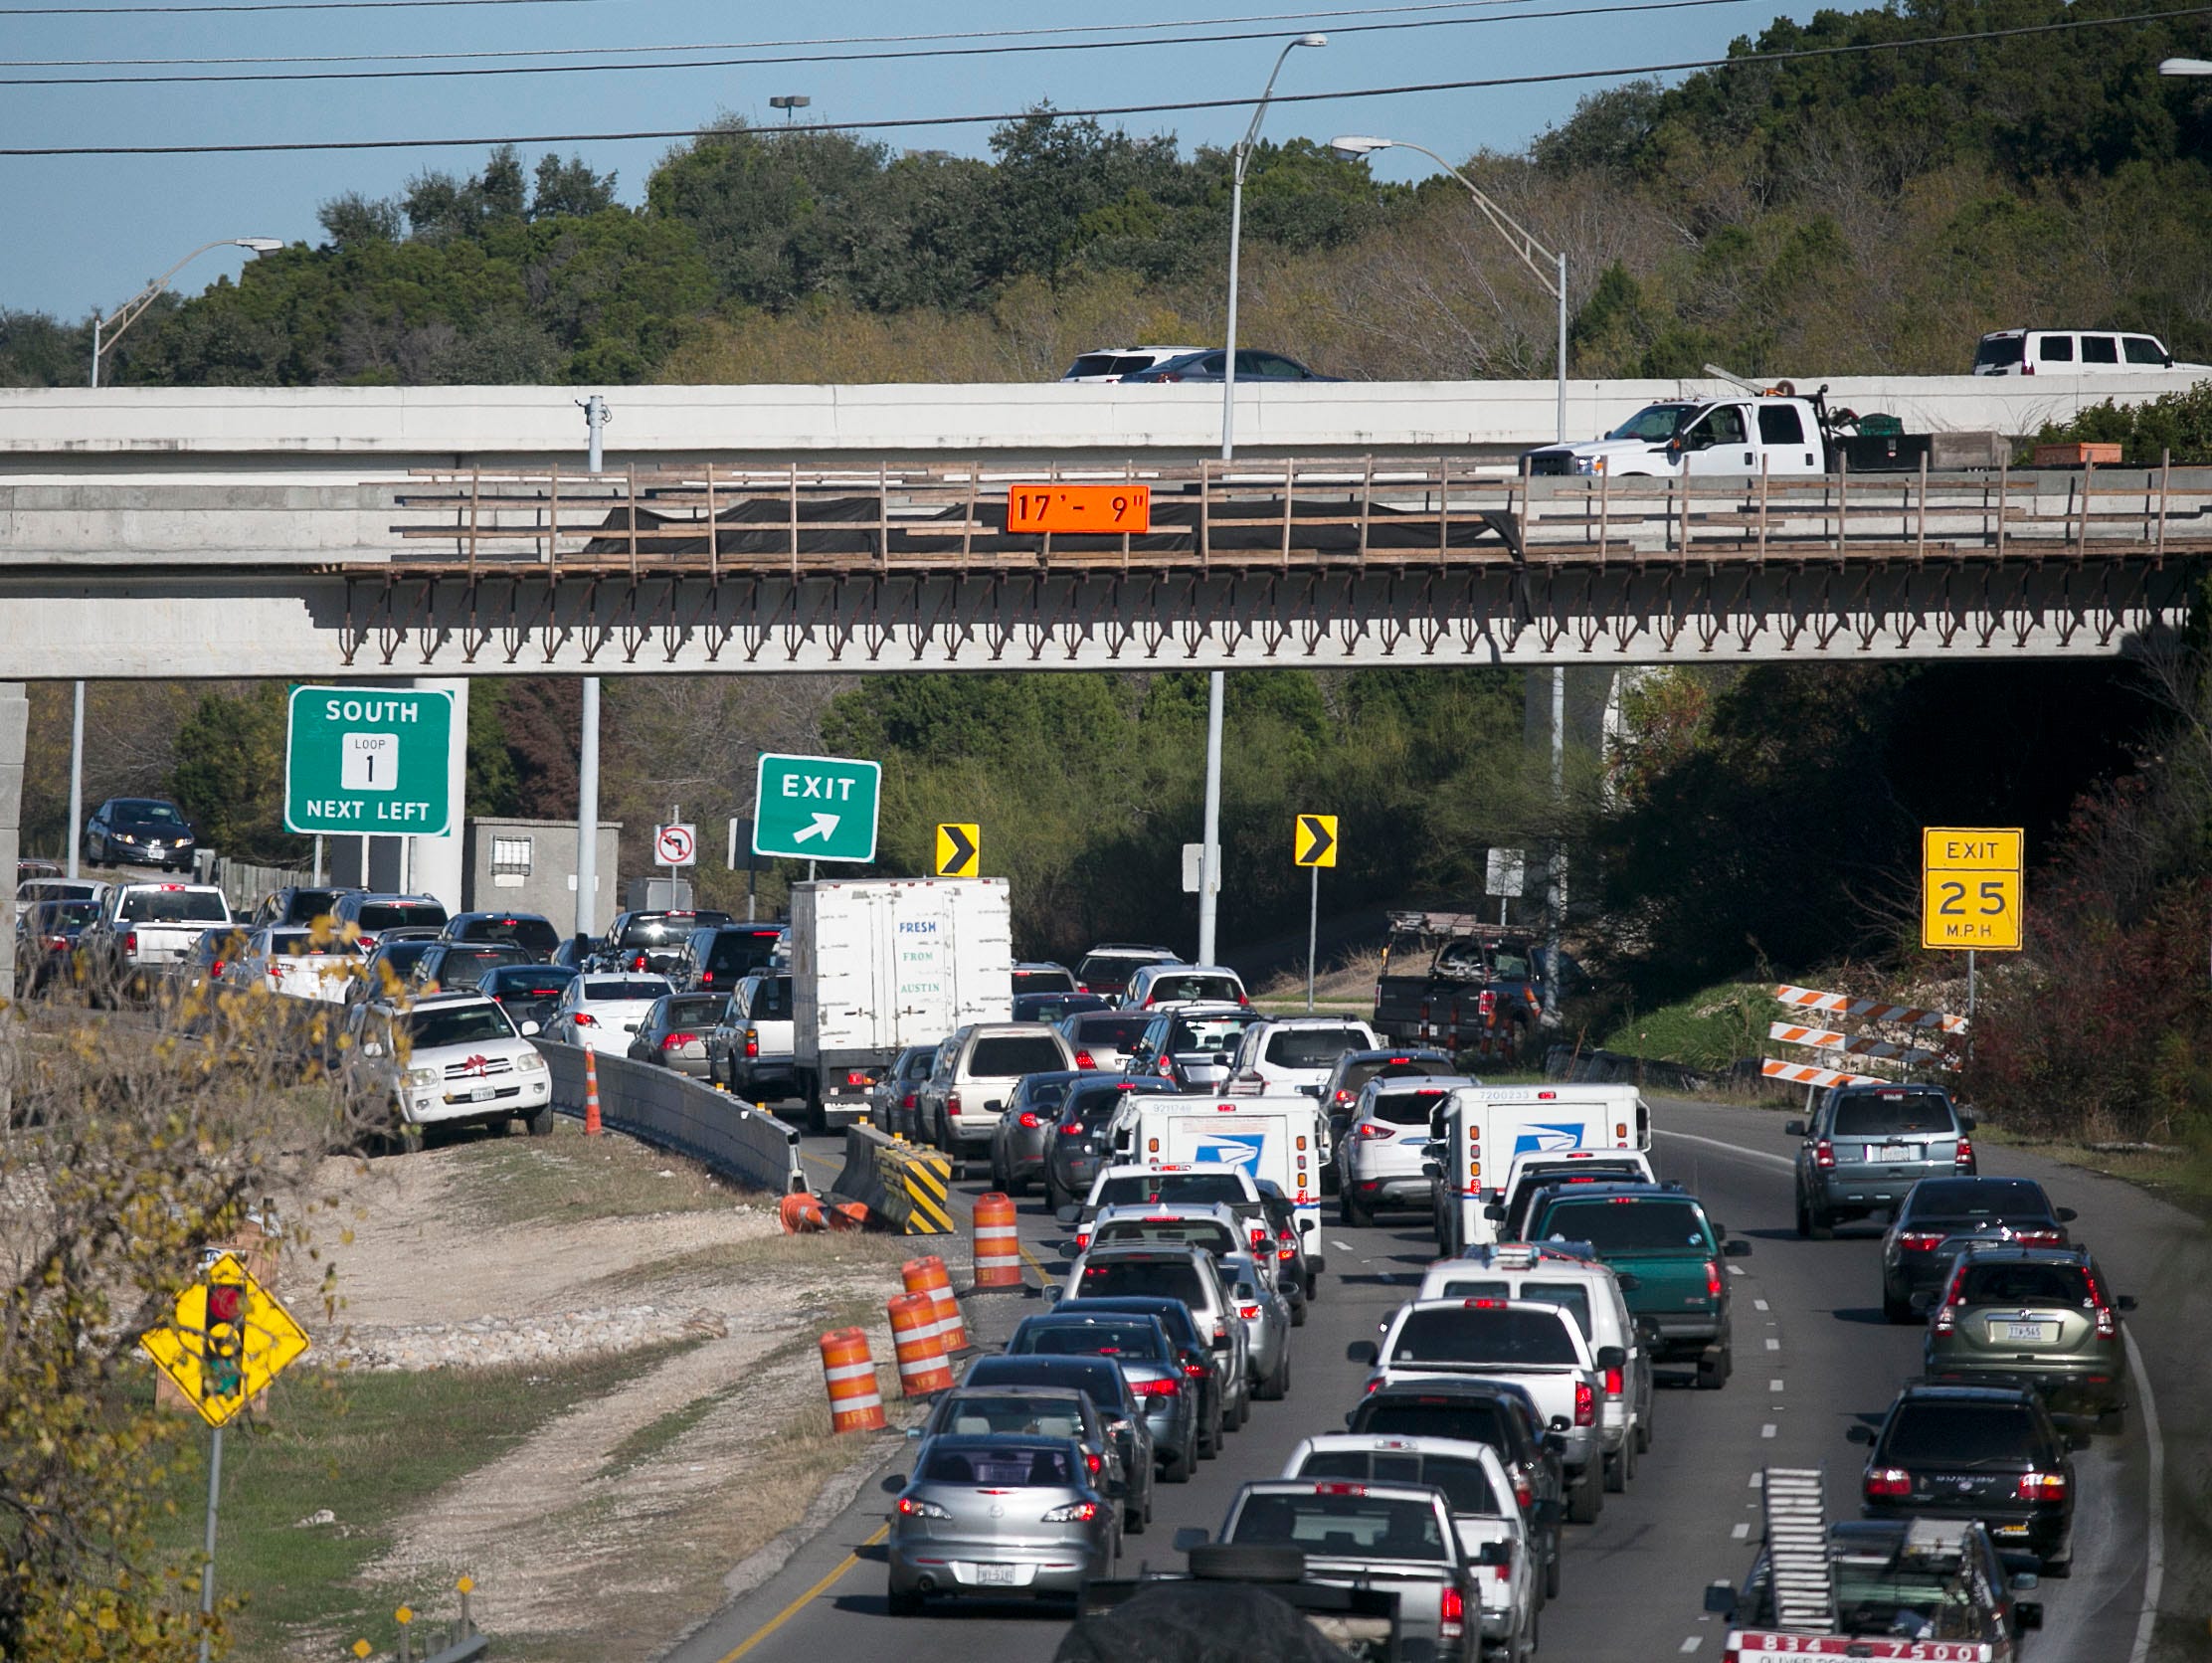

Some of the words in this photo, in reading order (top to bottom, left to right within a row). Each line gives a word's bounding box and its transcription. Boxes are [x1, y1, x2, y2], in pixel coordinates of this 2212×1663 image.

[325, 699, 418, 723] SOUTH
[354, 739, 386, 750] LOOP
[366, 755, 373, 783] 1
[782, 774, 855, 801] EXIT
[306, 800, 364, 819] NEXT
[377, 802, 430, 821] LEFT
[1947, 841, 1999, 859] EXIT
[1939, 881, 2005, 915] 25
[899, 921, 936, 933] FRESH
[902, 952, 933, 962] FROM
[900, 983, 940, 994] AUSTIN
[1762, 1635, 1822, 1652] 834
[1889, 1643, 1972, 1661] 7500
